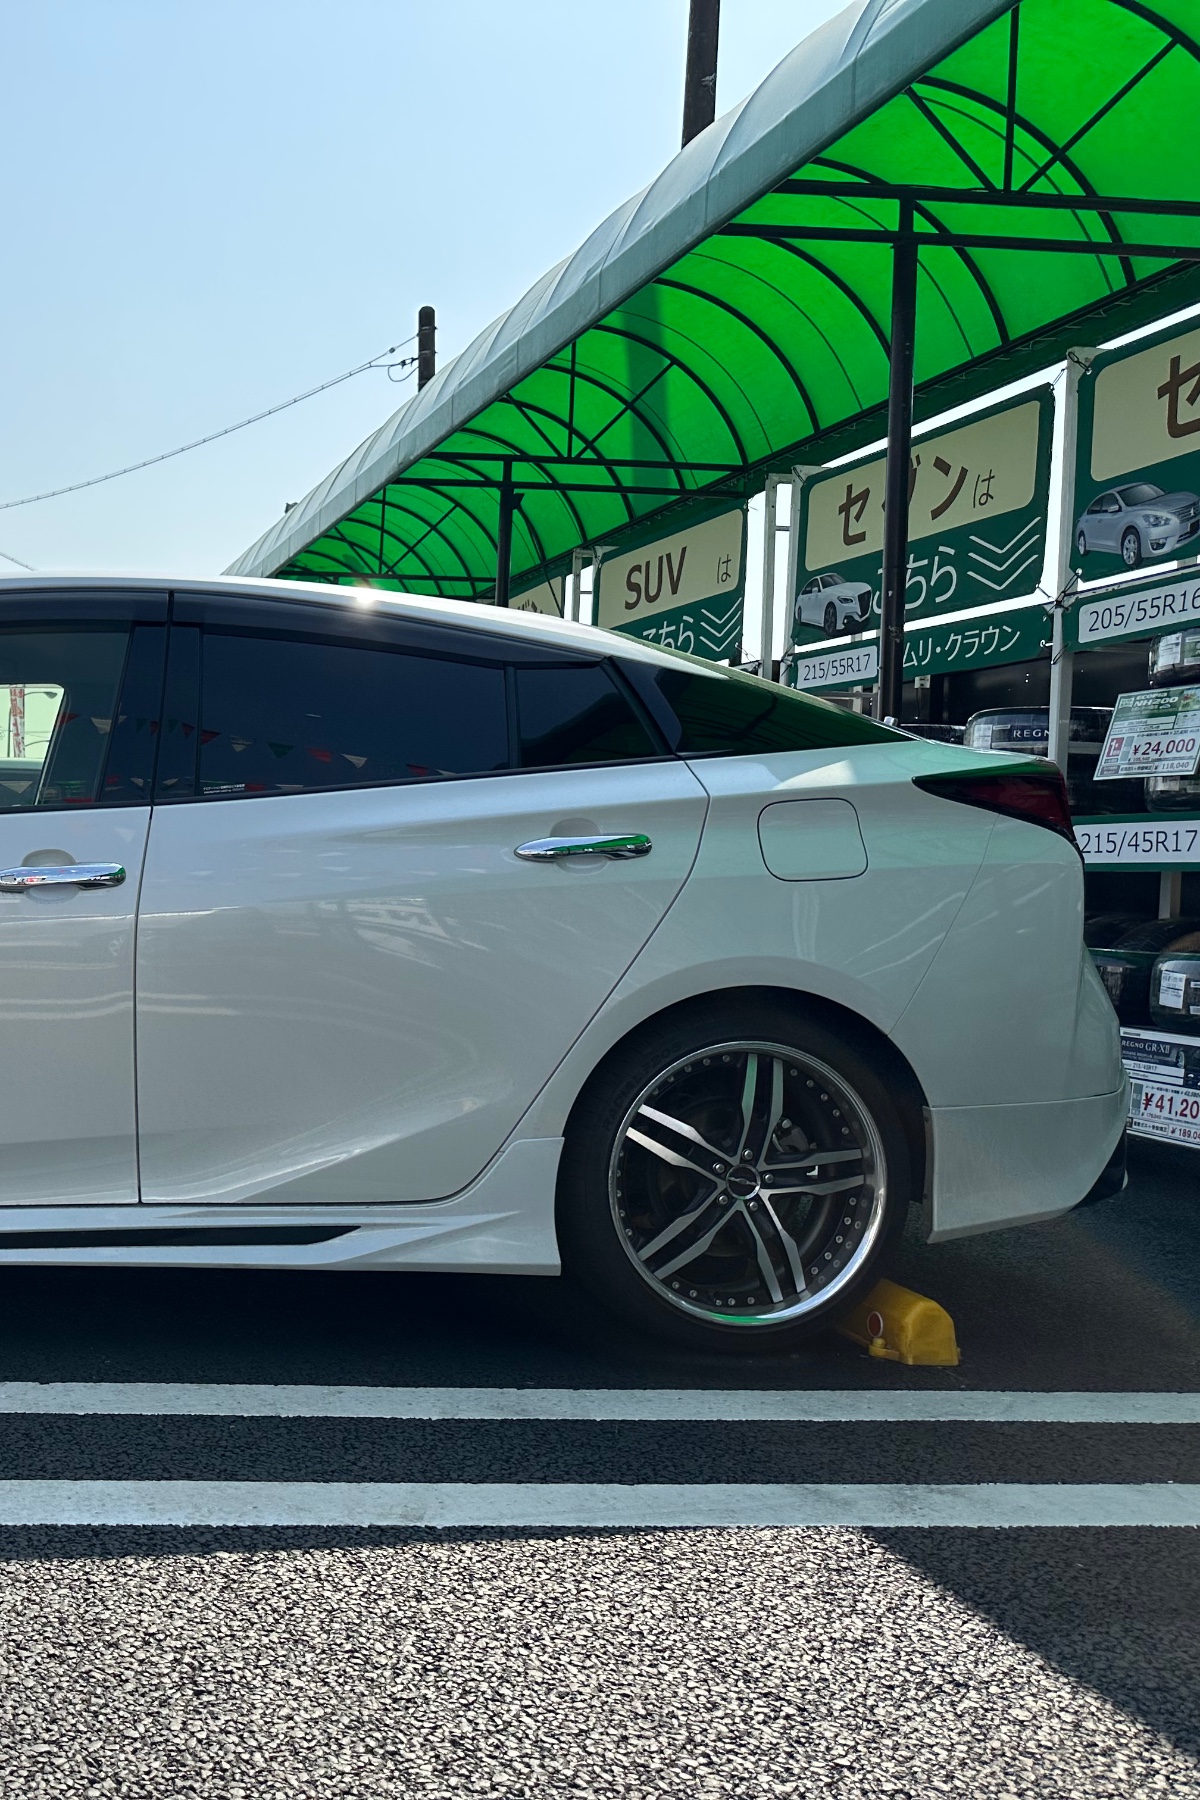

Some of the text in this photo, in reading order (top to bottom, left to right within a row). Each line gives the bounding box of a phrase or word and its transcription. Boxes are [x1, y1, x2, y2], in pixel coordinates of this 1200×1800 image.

[624, 546, 687, 610] SUV
[803, 653, 871, 681] 215/55R17
[1133, 696, 1179, 707] NH200
[1133, 738, 1196, 757] ¥24,000
[1080, 829, 1198, 857] 215/45R17
[1121, 1040, 1144, 1049] REGNO
